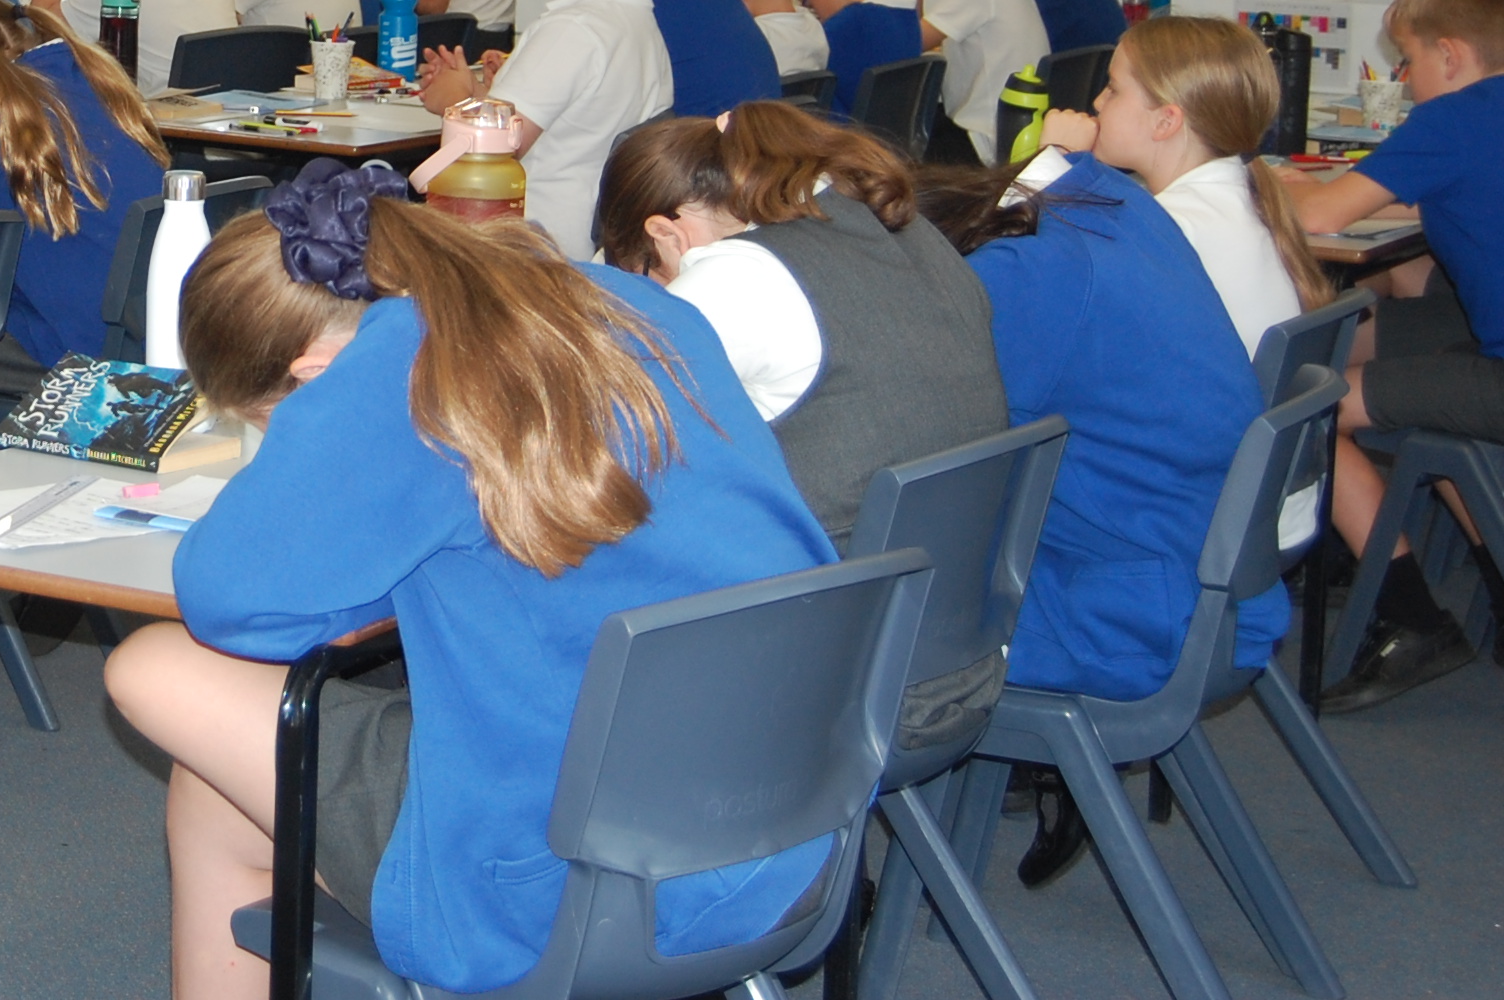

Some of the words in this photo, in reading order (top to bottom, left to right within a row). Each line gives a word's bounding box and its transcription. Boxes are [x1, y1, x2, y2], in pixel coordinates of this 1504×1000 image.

[18, 364, 88, 426] STORM
[37, 360, 111, 438] RUNNERS
[32, 438, 71, 455] RUNNERS
[149, 421, 182, 453] BARBARA
